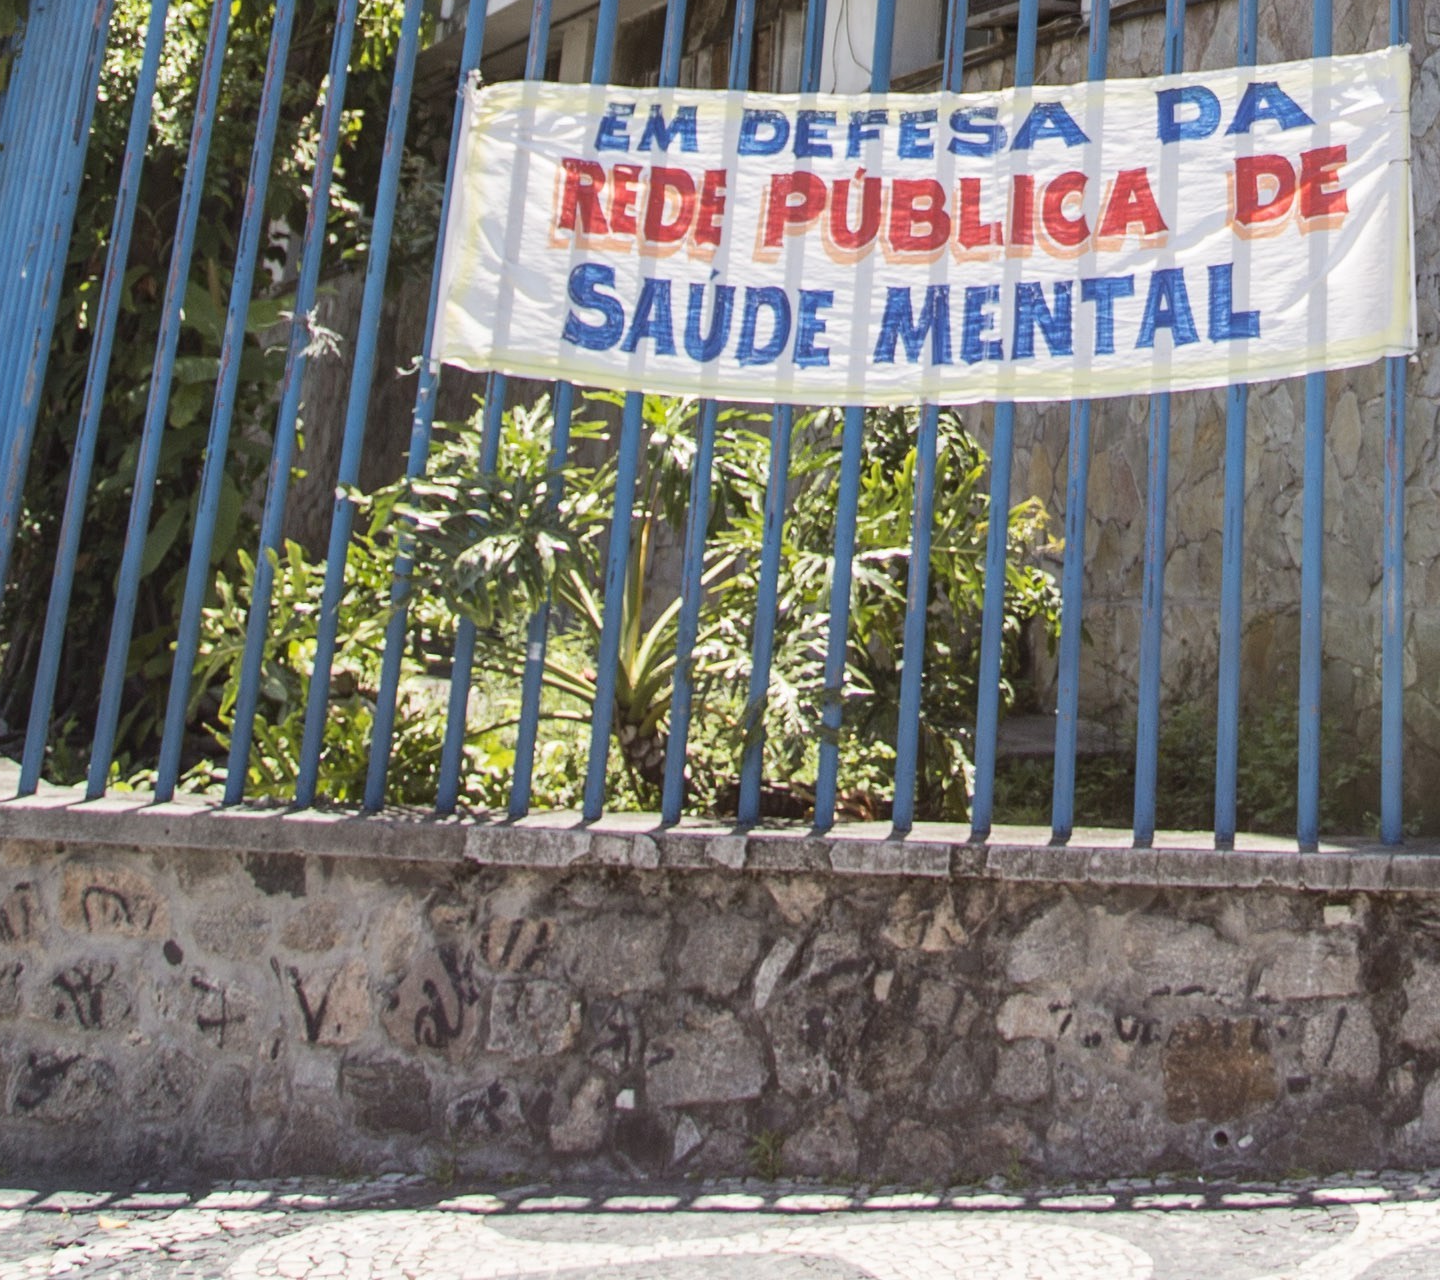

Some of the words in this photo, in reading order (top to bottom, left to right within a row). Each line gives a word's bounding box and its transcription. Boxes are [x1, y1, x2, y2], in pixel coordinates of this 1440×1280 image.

[595, 102, 698, 153] EM
[737, 101, 1091, 160] DEFESA
[1157, 81, 1315, 144] DA
[553, 158, 727, 252] REDE
[758, 166, 1169, 258] PÚBLICA
[1229, 145, 1349, 233] DE
[563, 262, 834, 369] SAÚDE
[873, 262, 1260, 366] MENTAL
